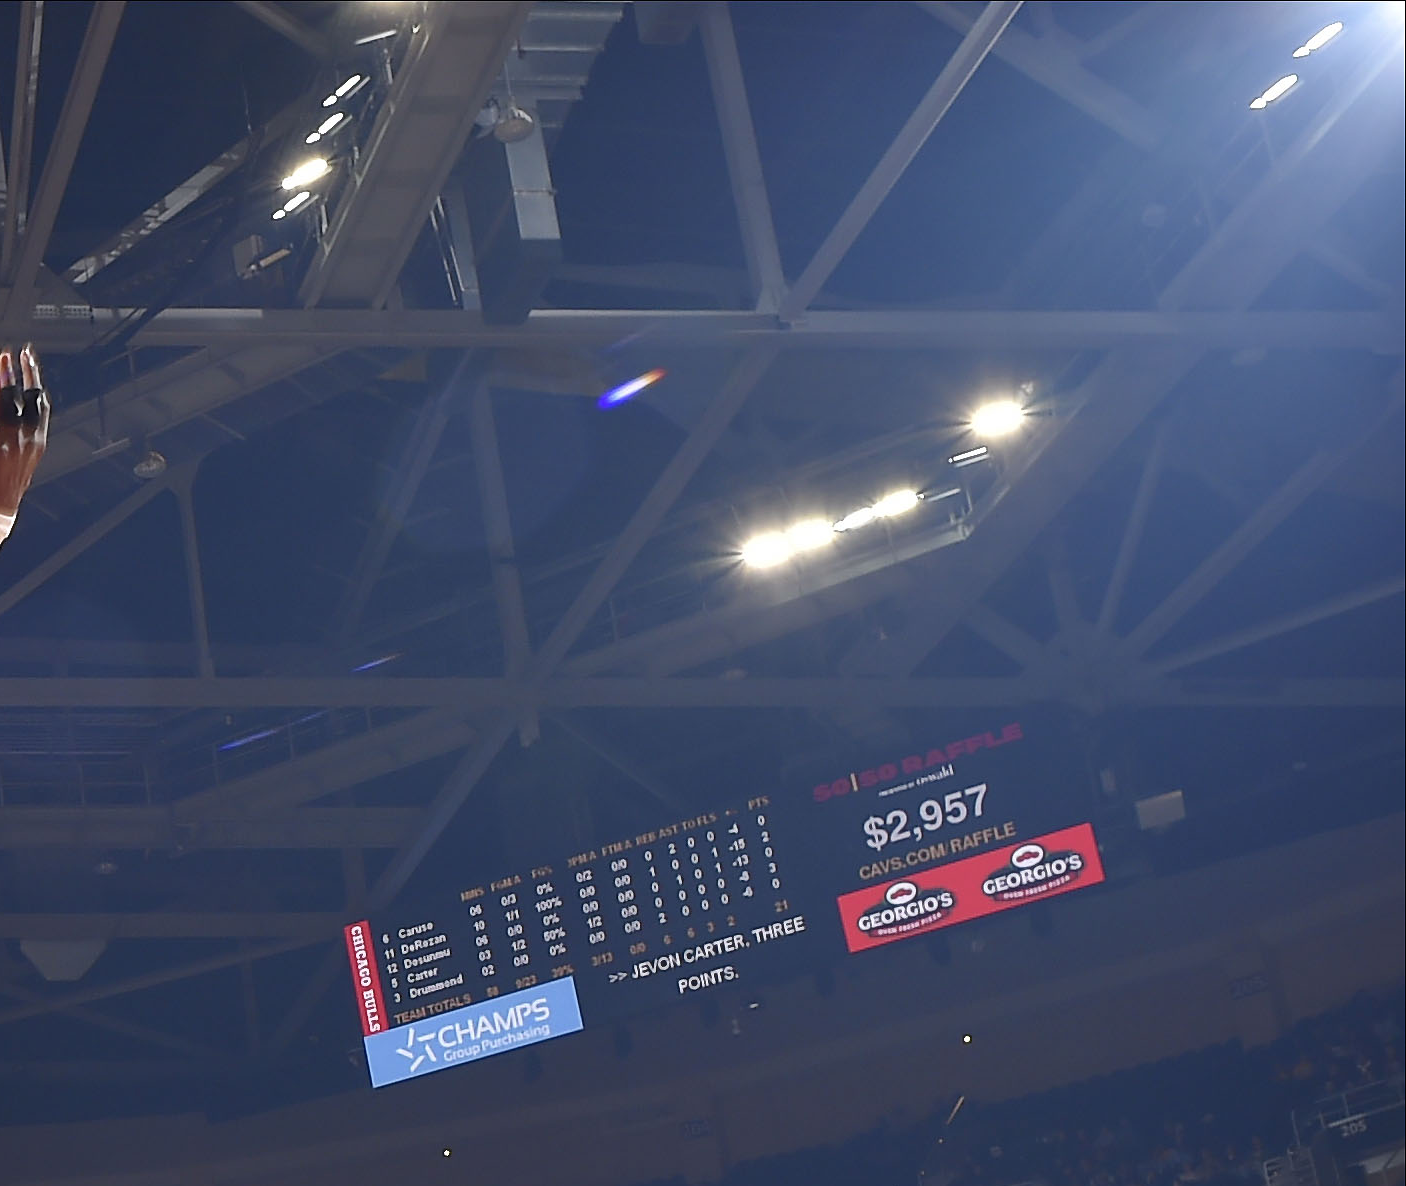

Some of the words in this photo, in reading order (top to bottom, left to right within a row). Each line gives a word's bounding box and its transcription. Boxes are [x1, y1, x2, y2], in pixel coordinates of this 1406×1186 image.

[863, 783, 988, 851] $2,957
[982, 854, 1083, 895] GEORGIO'S
[857, 891, 953, 931] GEORGIO'S
[398, 921, 434, 939] Caruso
[401, 933, 447, 955] DeRozan
[404, 948, 451, 970] Dosunmu
[631, 953, 681, 980] JEVON
[755, 915, 806, 947] THREE
[350, 925, 372, 988] CHICAGO
[362, 989, 381, 1032] BULLS
[407, 967, 438, 984] Carter
[409, 973, 464, 999] Drummond
[677, 965, 740, 994] POINTS.
[394, 1006, 426, 1024] TEAM
[427, 994, 471, 1017] TOTALS
[438, 998, 550, 1048] CHAMPS
[444, 1040, 481, 1063] Group
[482, 1024, 550, 1051] Purchasing
